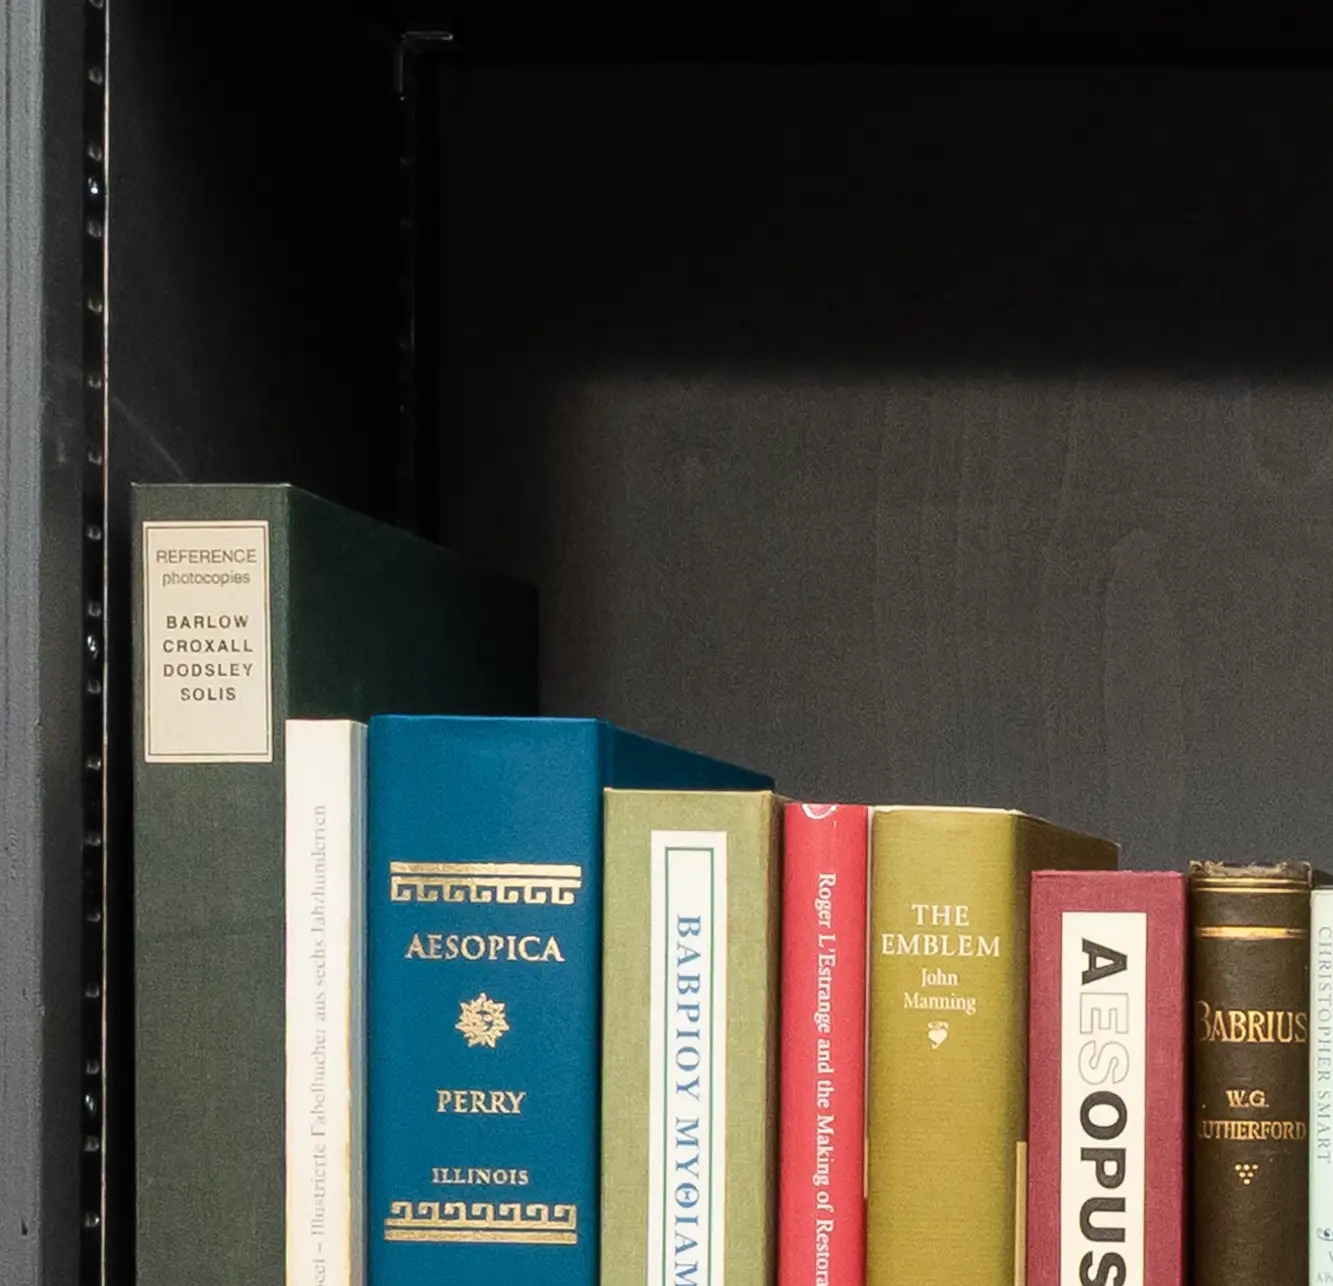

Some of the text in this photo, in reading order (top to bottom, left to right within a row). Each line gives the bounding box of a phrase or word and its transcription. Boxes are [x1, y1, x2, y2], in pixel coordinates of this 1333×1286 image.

[156, 549, 256, 563] REFERENCE
[163, 572, 250, 587] photocopies
[167, 615, 247, 629] BARLOW
[163, 640, 252, 653] CROXALL
[164, 664, 252, 677] DODSLEY
[181, 687, 235, 701] SOLIS
[815, 874, 836, 928] Roger
[912, 904, 969, 926] THE
[405, 934, 565, 961] AESOPICA
[881, 934, 1000, 957] EMBLEM
[814, 934, 835, 1033] L'Estrange
[922, 968, 957, 987] John
[904, 992, 976, 1015] Manning
[818, 1039, 834, 1073] and
[1317, 927, 1331, 1163] CHRISTOPHER SMART
[437, 1091, 526, 1113] PERRY
[817, 1080, 834, 1108] the
[813, 1115, 834, 1186] Making
[433, 1168, 528, 1185] ILLINOIS
[817, 1192, 833, 1212] of
